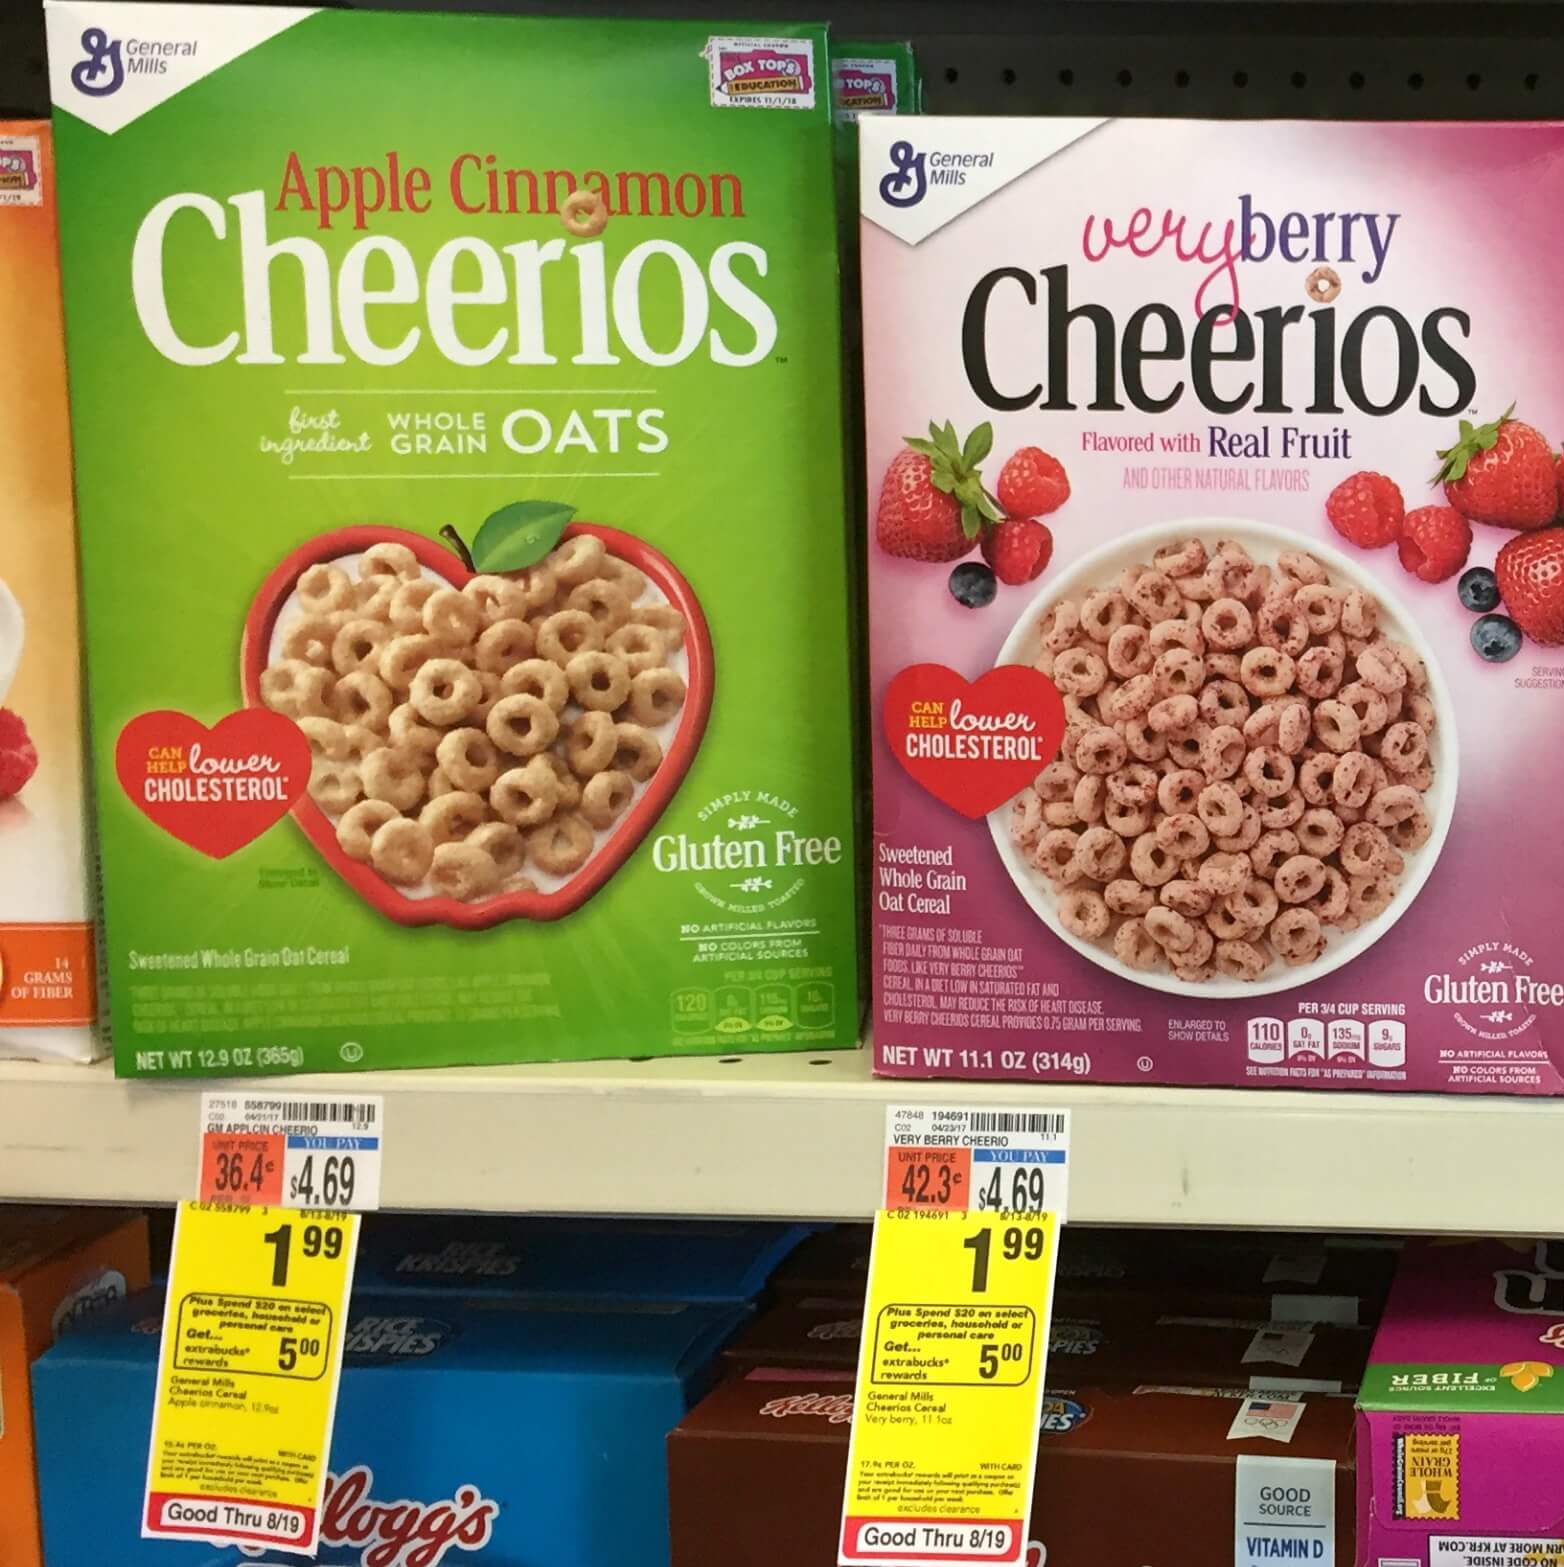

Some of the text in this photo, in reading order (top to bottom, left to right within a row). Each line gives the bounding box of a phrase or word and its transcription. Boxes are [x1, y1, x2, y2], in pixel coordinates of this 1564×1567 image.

[126, 39, 198, 58] General
[127, 56, 168, 75] Mills
[724, 62, 754, 80] BOX
[929, 151, 993, 170] General
[930, 168, 966, 186] Mills
[276, 151, 746, 231] Apple Cinnamon
[131, 190, 780, 368] Cheerios
[962, 264, 1477, 417] Cheerios
[287, 406, 340, 430] first
[388, 413, 485, 429] WHOLE
[502, 408, 669, 454] OATS
[259, 431, 372, 465] ingredient
[390, 434, 487, 454] GRAIN
[1082, 427, 1351, 459] Flavored with Real Fruit
[1123, 468, 1310, 492] AND OTHER NATURAL FLAVORS
[912, 702, 944, 714] CAN
[950, 699, 1036, 731] lower
[909, 716, 947, 728] HELP
[148, 748, 182, 760] CAN
[189, 743, 281, 774] lower
[146, 760, 186, 773] HELP
[653, 831, 842, 872] Gluten Free
[880, 843, 952, 865] Sweetened
[880, 867, 966, 890] Whole Grain
[880, 892, 950, 914] Oat Cereal
[24, 971, 72, 984] GRAMS
[11, 986, 73, 999] OF FIBER
[1424, 975, 1564, 1006] Gluten Free
[137, 1052, 164, 1071] NET
[170, 1051, 192, 1069] WT
[198, 1050, 228, 1067] 12.9
[233, 1049, 252, 1066] OZ
[883, 1045, 1090, 1074] NET WT 11.1 OZ (314g)
[894, 1135, 1008, 1146] VERY BERRY CHEERIO
[290, 1155, 354, 1205] $4.69
[979, 1167, 1044, 1213] $4.69
[1259, 1487, 1311, 1504] GOOD
[168, 1503, 300, 1533] Good Thru 8/19
[1258, 1504, 1312, 1518] SOURCE
[865, 1527, 1005, 1548] Good Thru 8/19
[1247, 1538, 1324, 1559] VITAMIN D
